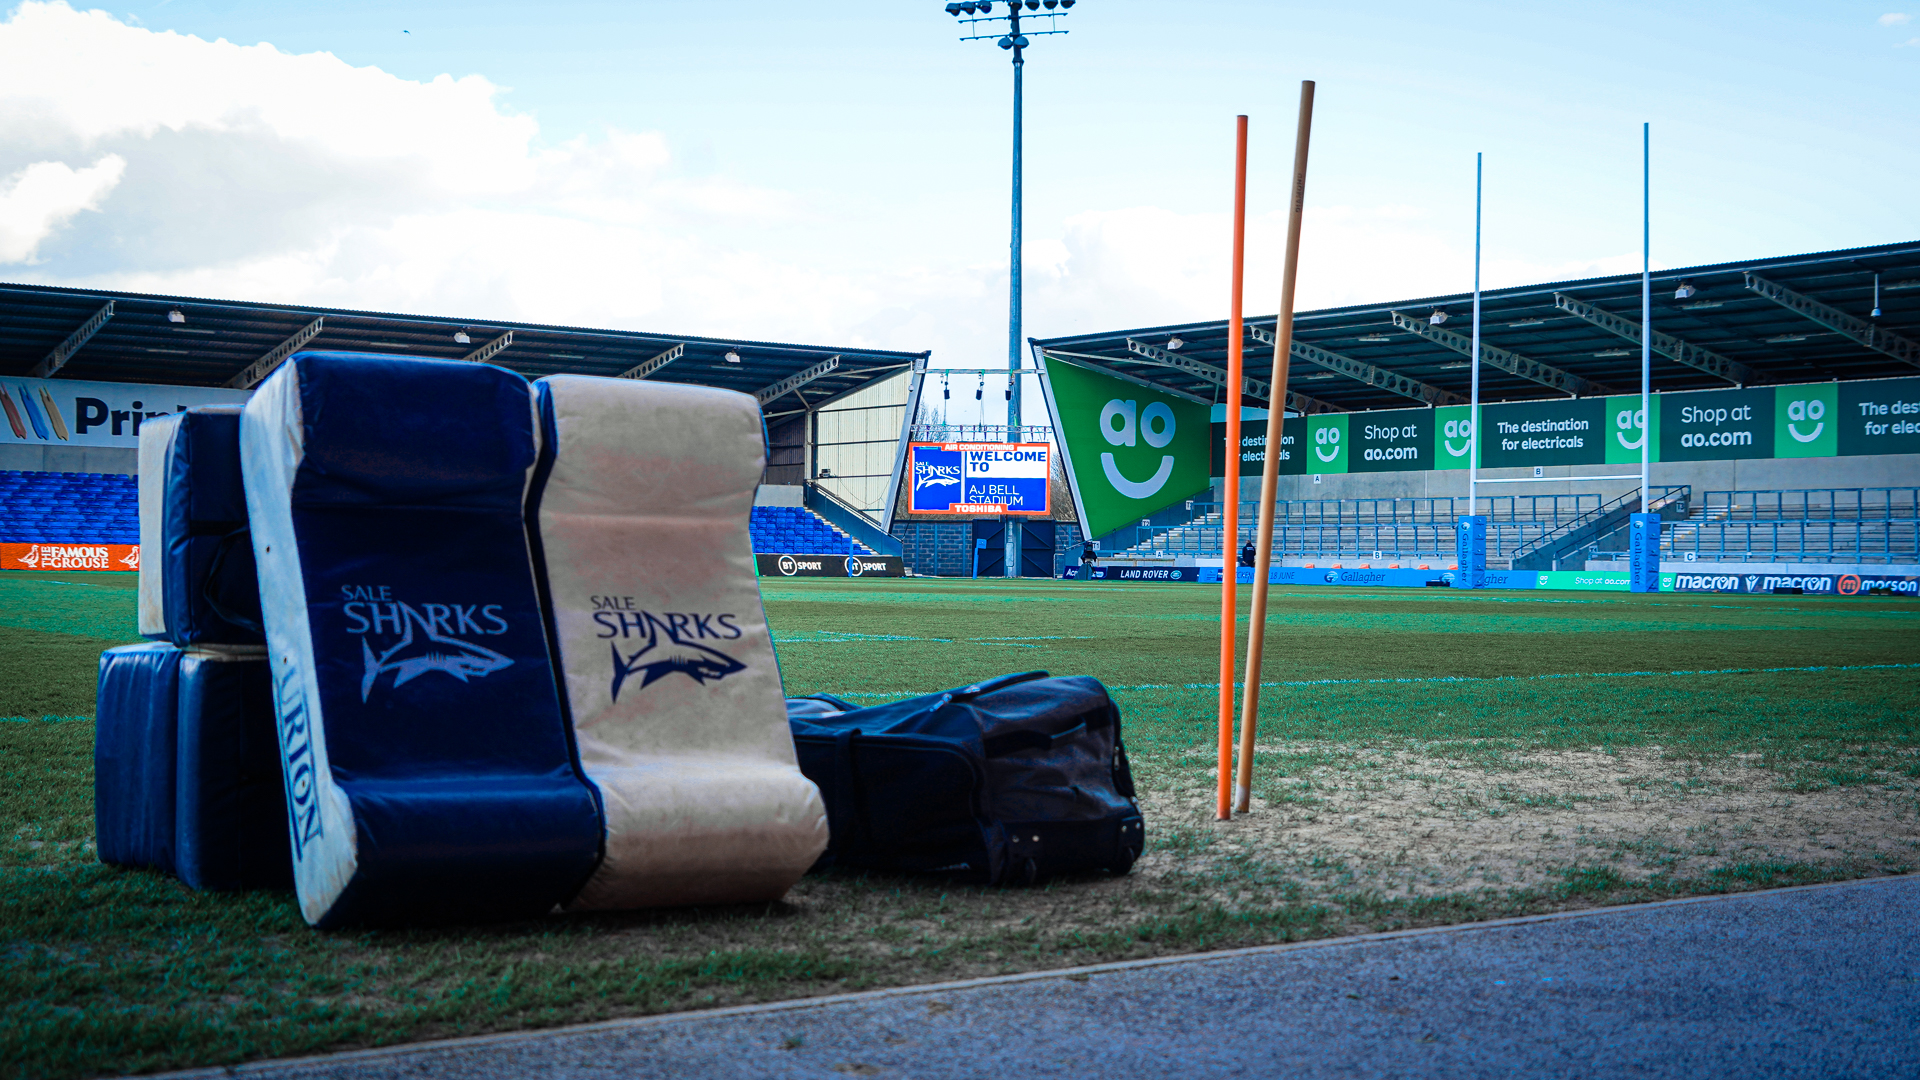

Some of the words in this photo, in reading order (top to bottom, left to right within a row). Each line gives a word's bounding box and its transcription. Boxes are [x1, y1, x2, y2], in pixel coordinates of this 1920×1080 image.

[1681, 406, 1727, 425] Shop
[1731, 405, 1751, 421] at
[1788, 400, 1825, 420] ao
[1858, 401, 1888, 416] The
[1100, 398, 1176, 448] ao
[1444, 419, 1471, 438] ao
[1497, 422, 1519, 434] The
[1521, 418, 1589, 433] destination
[1864, 421, 1889, 435] for
[1315, 427, 1340, 444] ao
[1364, 425, 1399, 442] Shop
[1402, 424, 1417, 438] at
[1681, 430, 1752, 447] ao.com
[1502, 438, 1519, 450] for
[1521, 435, 1584, 450] electricals
[970, 451, 1046, 461] WELCOME
[1364, 447, 1418, 461] ao.com
[970, 462, 989, 472] TO
[969, 484, 985, 495] AJ
[989, 484, 1019, 495] BELL
[969, 495, 1023, 506] STADIUM
[955, 505, 1002, 513] TOSHIBA
[41, 546, 51, 568] THE
[51, 546, 108, 558] FAMOUS
[51, 557, 109, 568] GROUSE
[1461, 533, 1469, 583] Gallagher
[1633, 532, 1642, 585] Gallagher
[782, 562, 793, 570] BT
[797, 562, 822, 571] SPORT
[863, 562, 887, 571] SPORT
[1120, 569, 1141, 579] LAND
[1142, 570, 1169, 579] ROVER
[1341, 571, 1386, 584] Gallagher
[1575, 576, 1594, 585] Shop
[1595, 577, 1603, 585] at
[1675, 575, 1740, 590] macron
[341, 585, 391, 602] SALE
[590, 596, 635, 611] SALE
[344, 600, 508, 637] SHARKS
[593, 610, 742, 640] SHARKS
